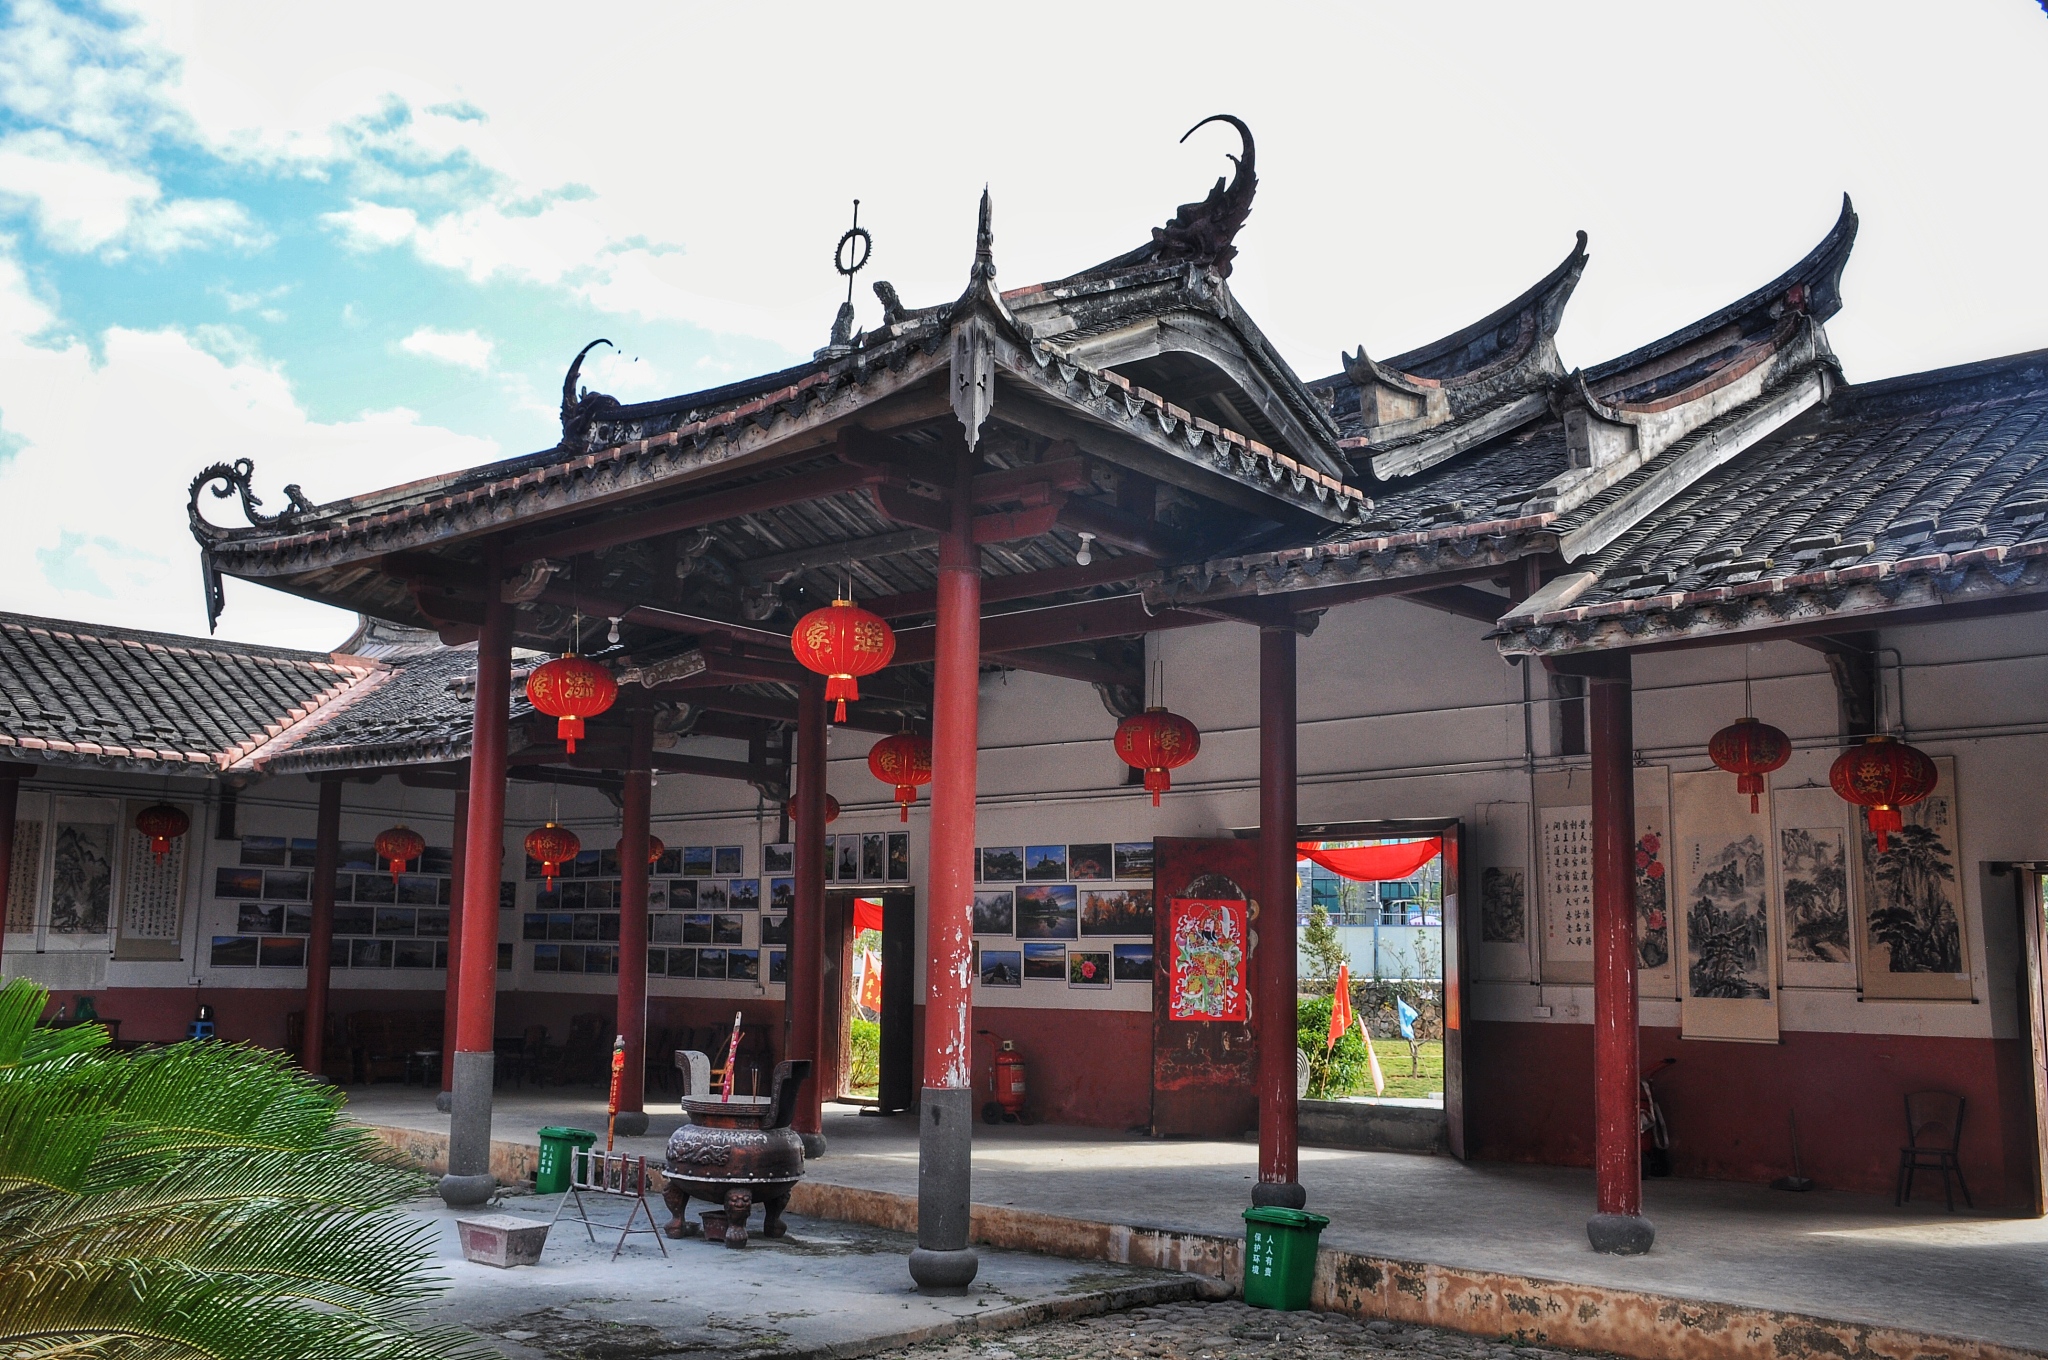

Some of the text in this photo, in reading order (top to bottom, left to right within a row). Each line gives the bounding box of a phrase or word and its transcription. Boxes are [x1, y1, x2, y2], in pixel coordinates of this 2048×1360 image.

[1252, 1232, 1261, 1275] 保护环境
[1264, 1235, 1274, 1277] 人人有责
